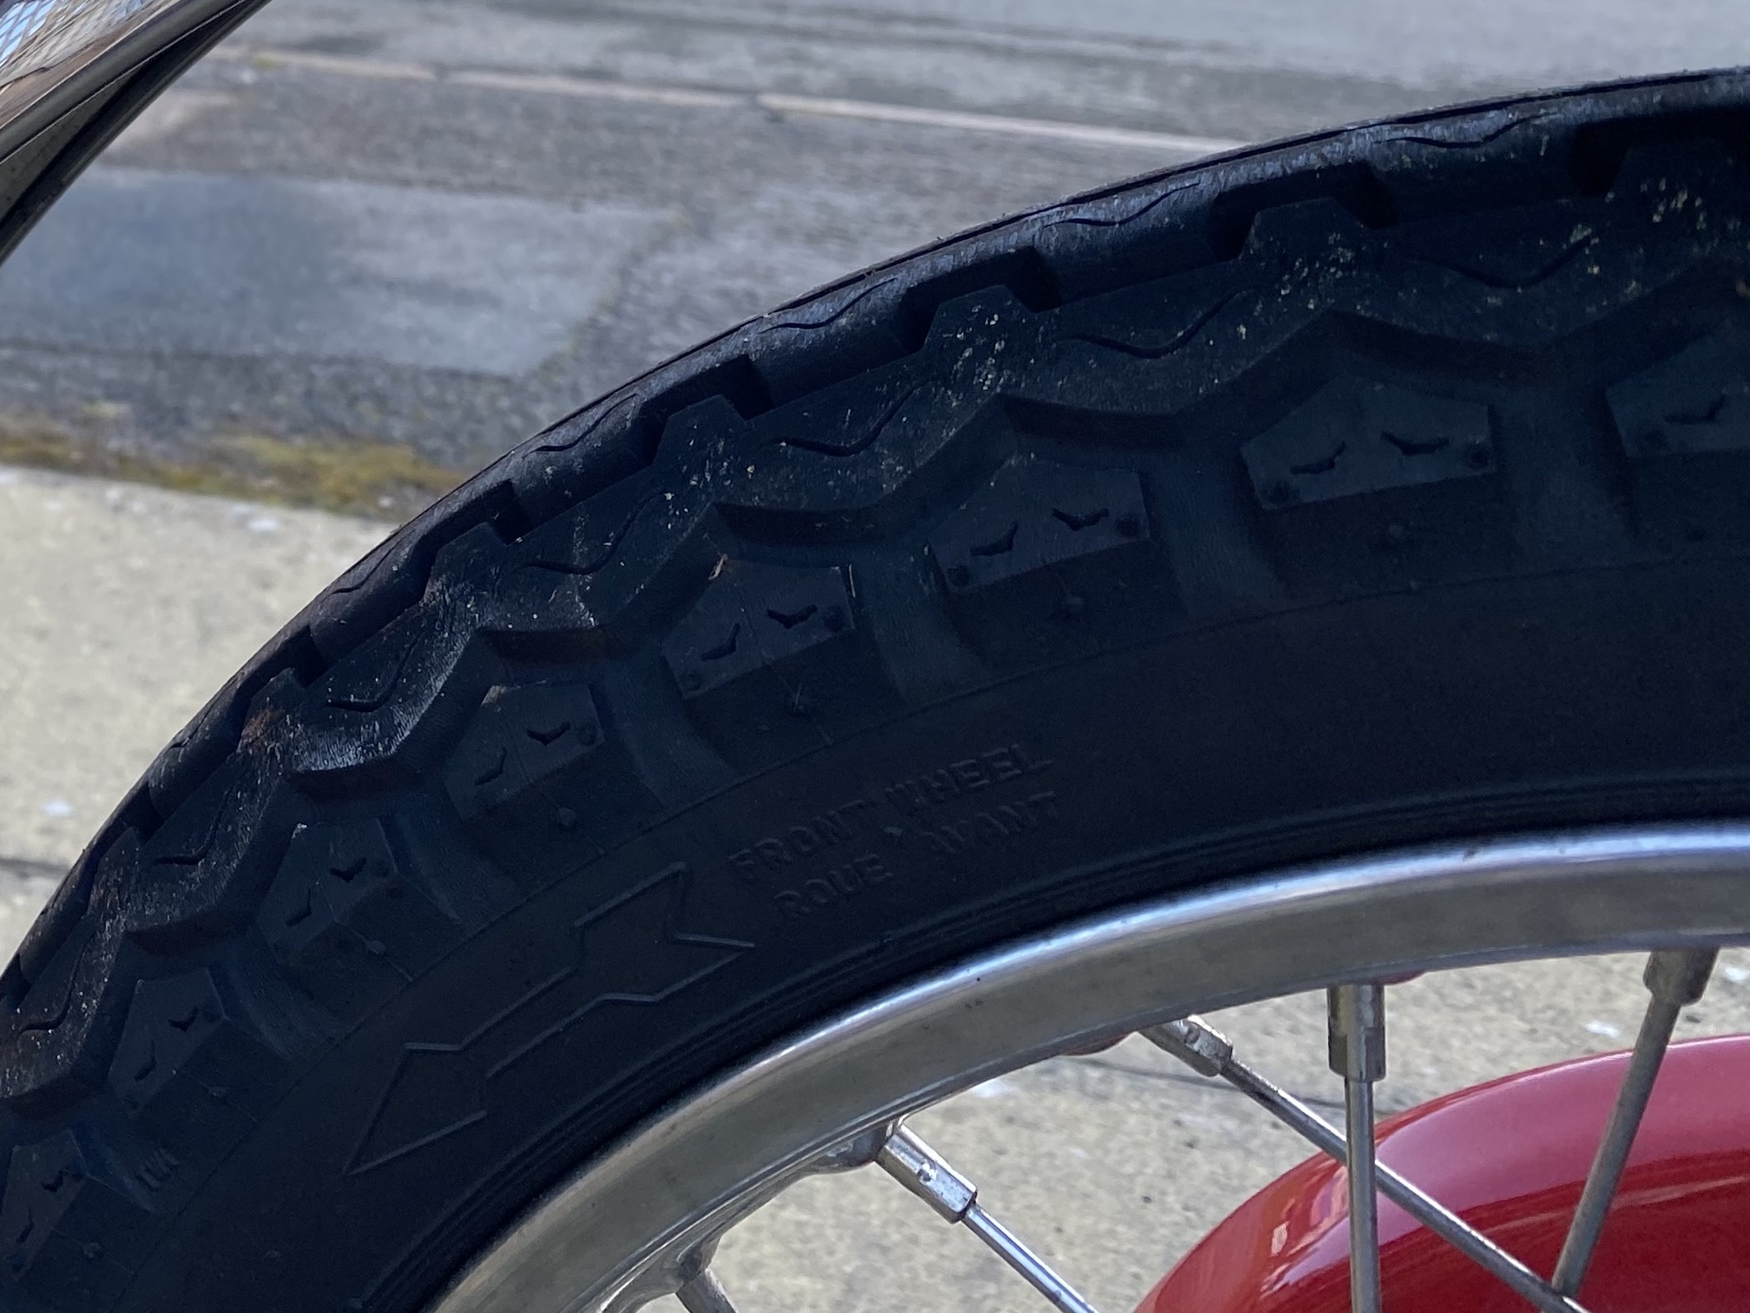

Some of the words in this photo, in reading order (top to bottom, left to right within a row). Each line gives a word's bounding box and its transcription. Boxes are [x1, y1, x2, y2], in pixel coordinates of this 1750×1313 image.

[727, 798, 869, 883] FRONT
[882, 742, 1057, 815] WHEEL
[772, 852, 895, 919] ROUE
